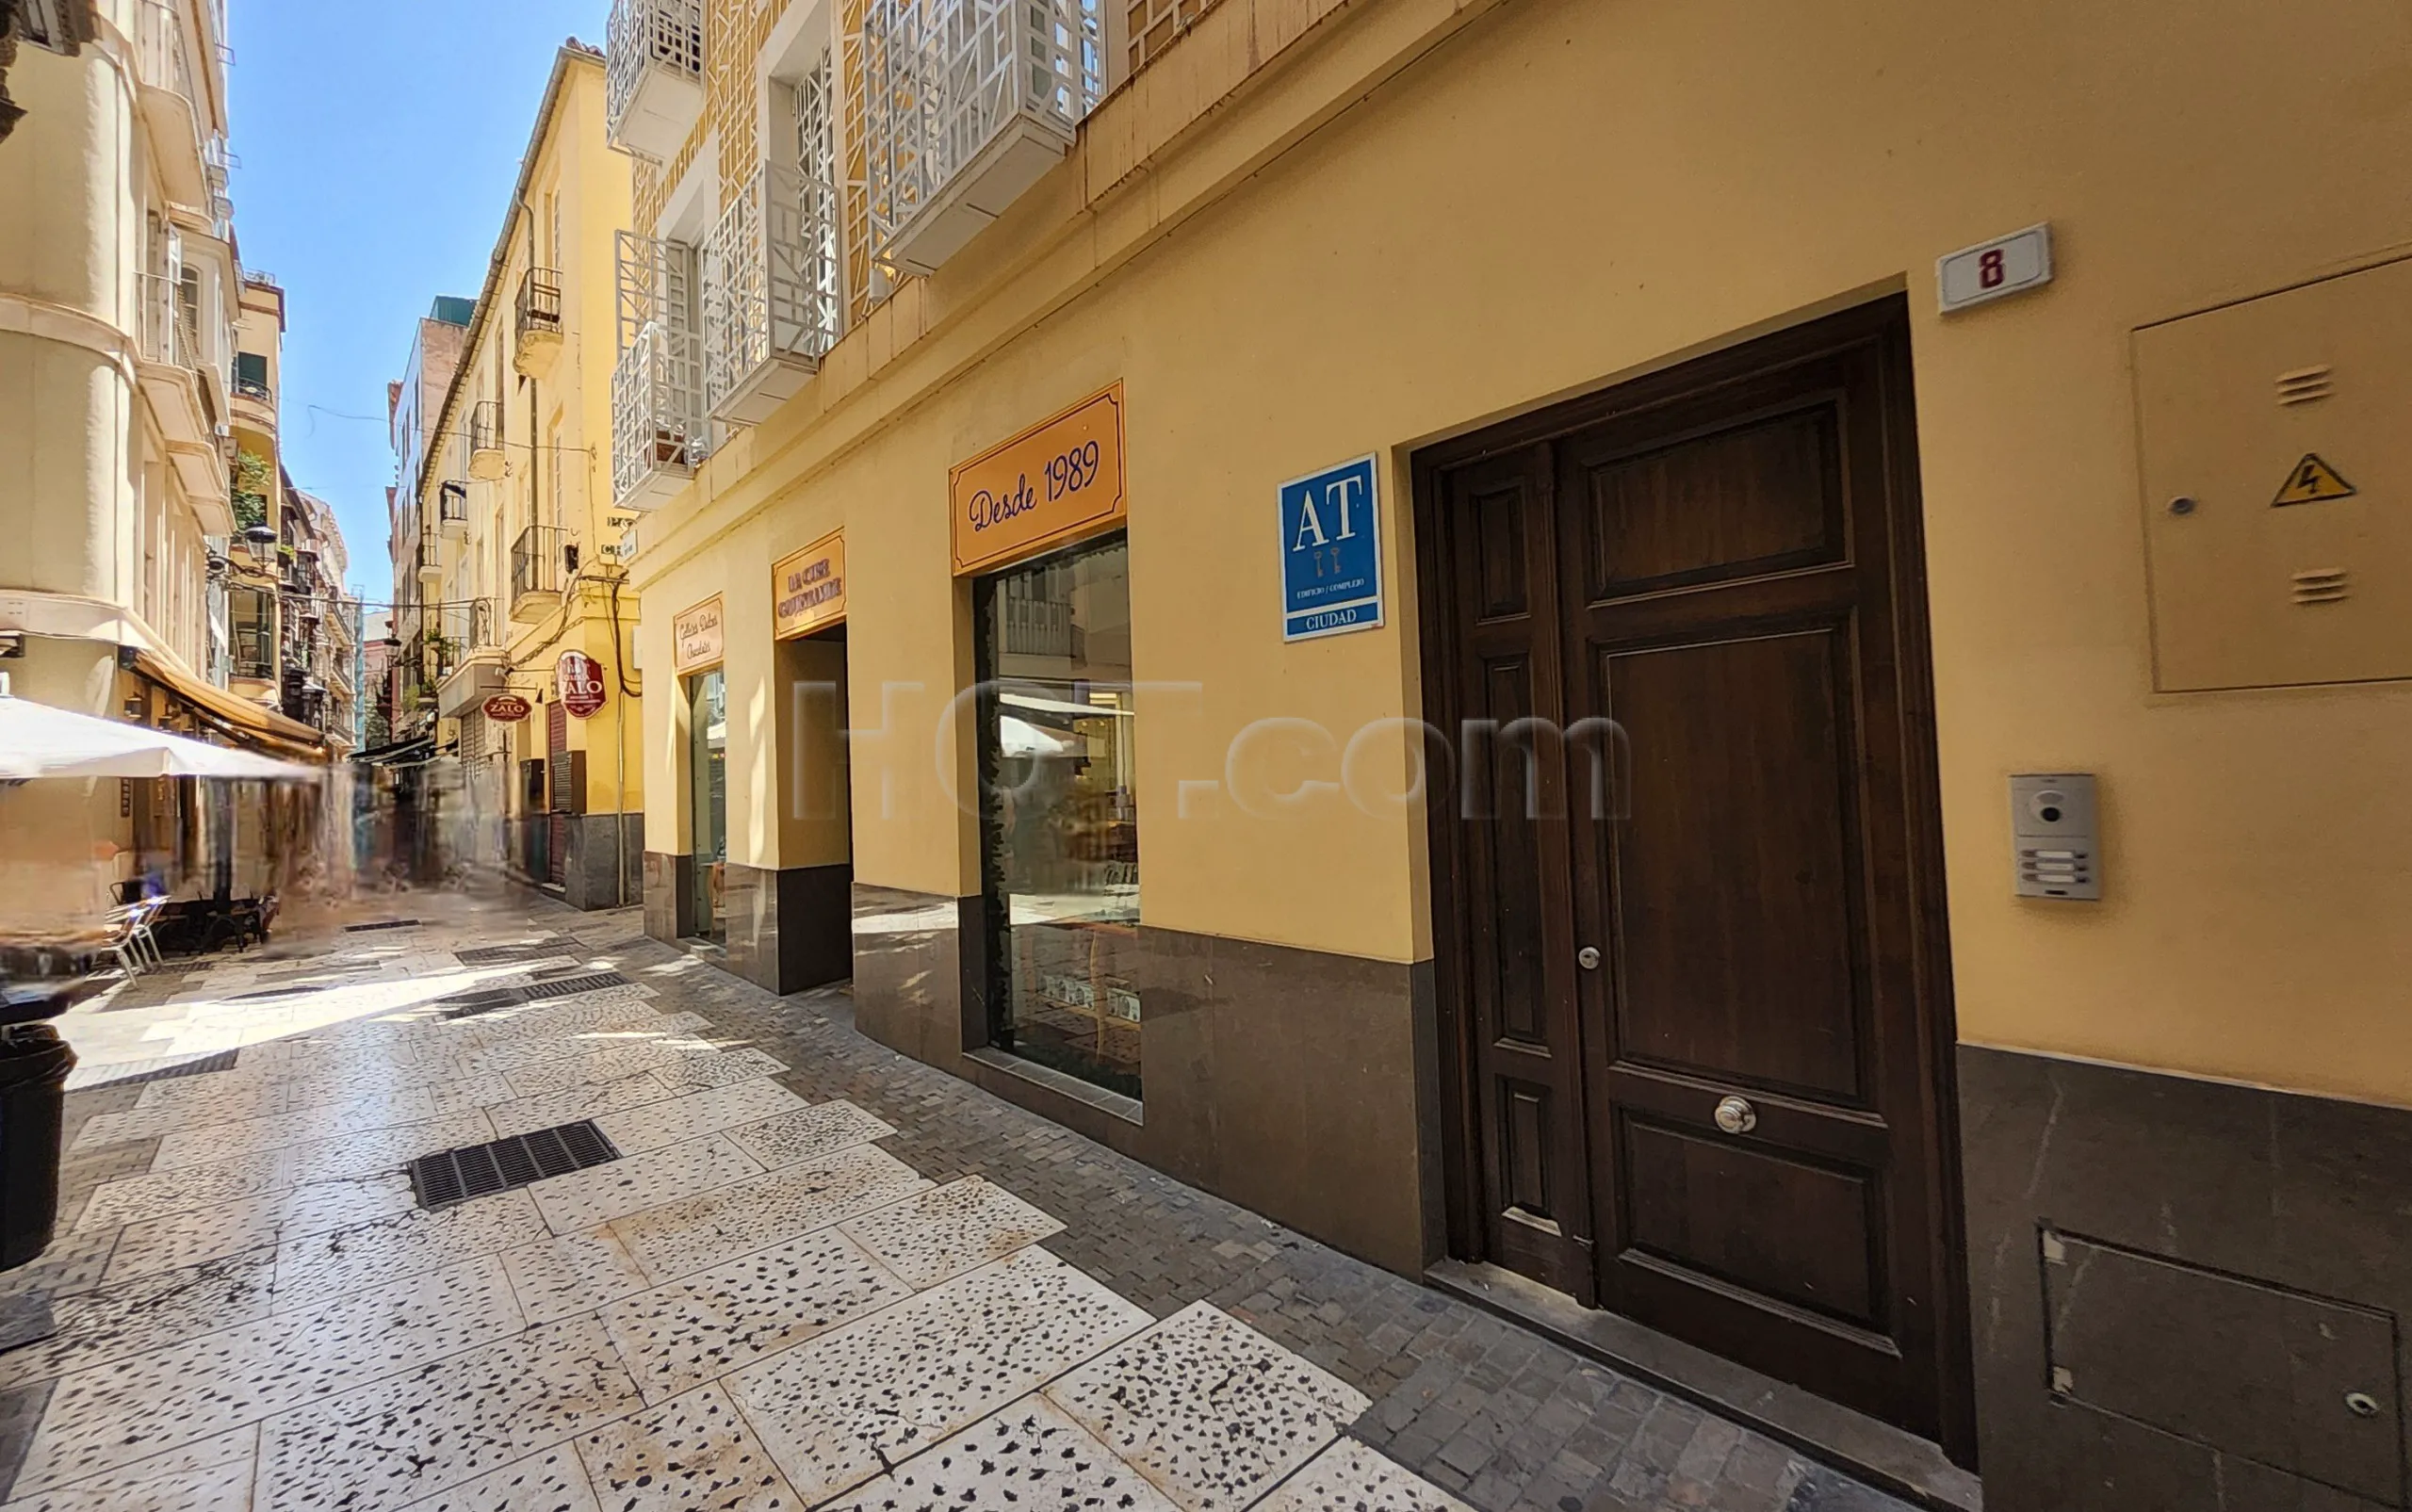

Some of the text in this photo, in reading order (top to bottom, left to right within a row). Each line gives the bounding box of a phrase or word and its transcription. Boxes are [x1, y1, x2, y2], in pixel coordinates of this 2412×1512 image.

[1980, 249, 2004, 289] 8
[969, 440, 1100, 532] Desde 1989
[1292, 474, 1363, 552] AT
[1329, 577, 1365, 593] COMPLEJO
[1306, 610, 1358, 630] CIUDAD
[560, 680, 602, 694] ALO
[490, 704, 525, 713] ZALO
